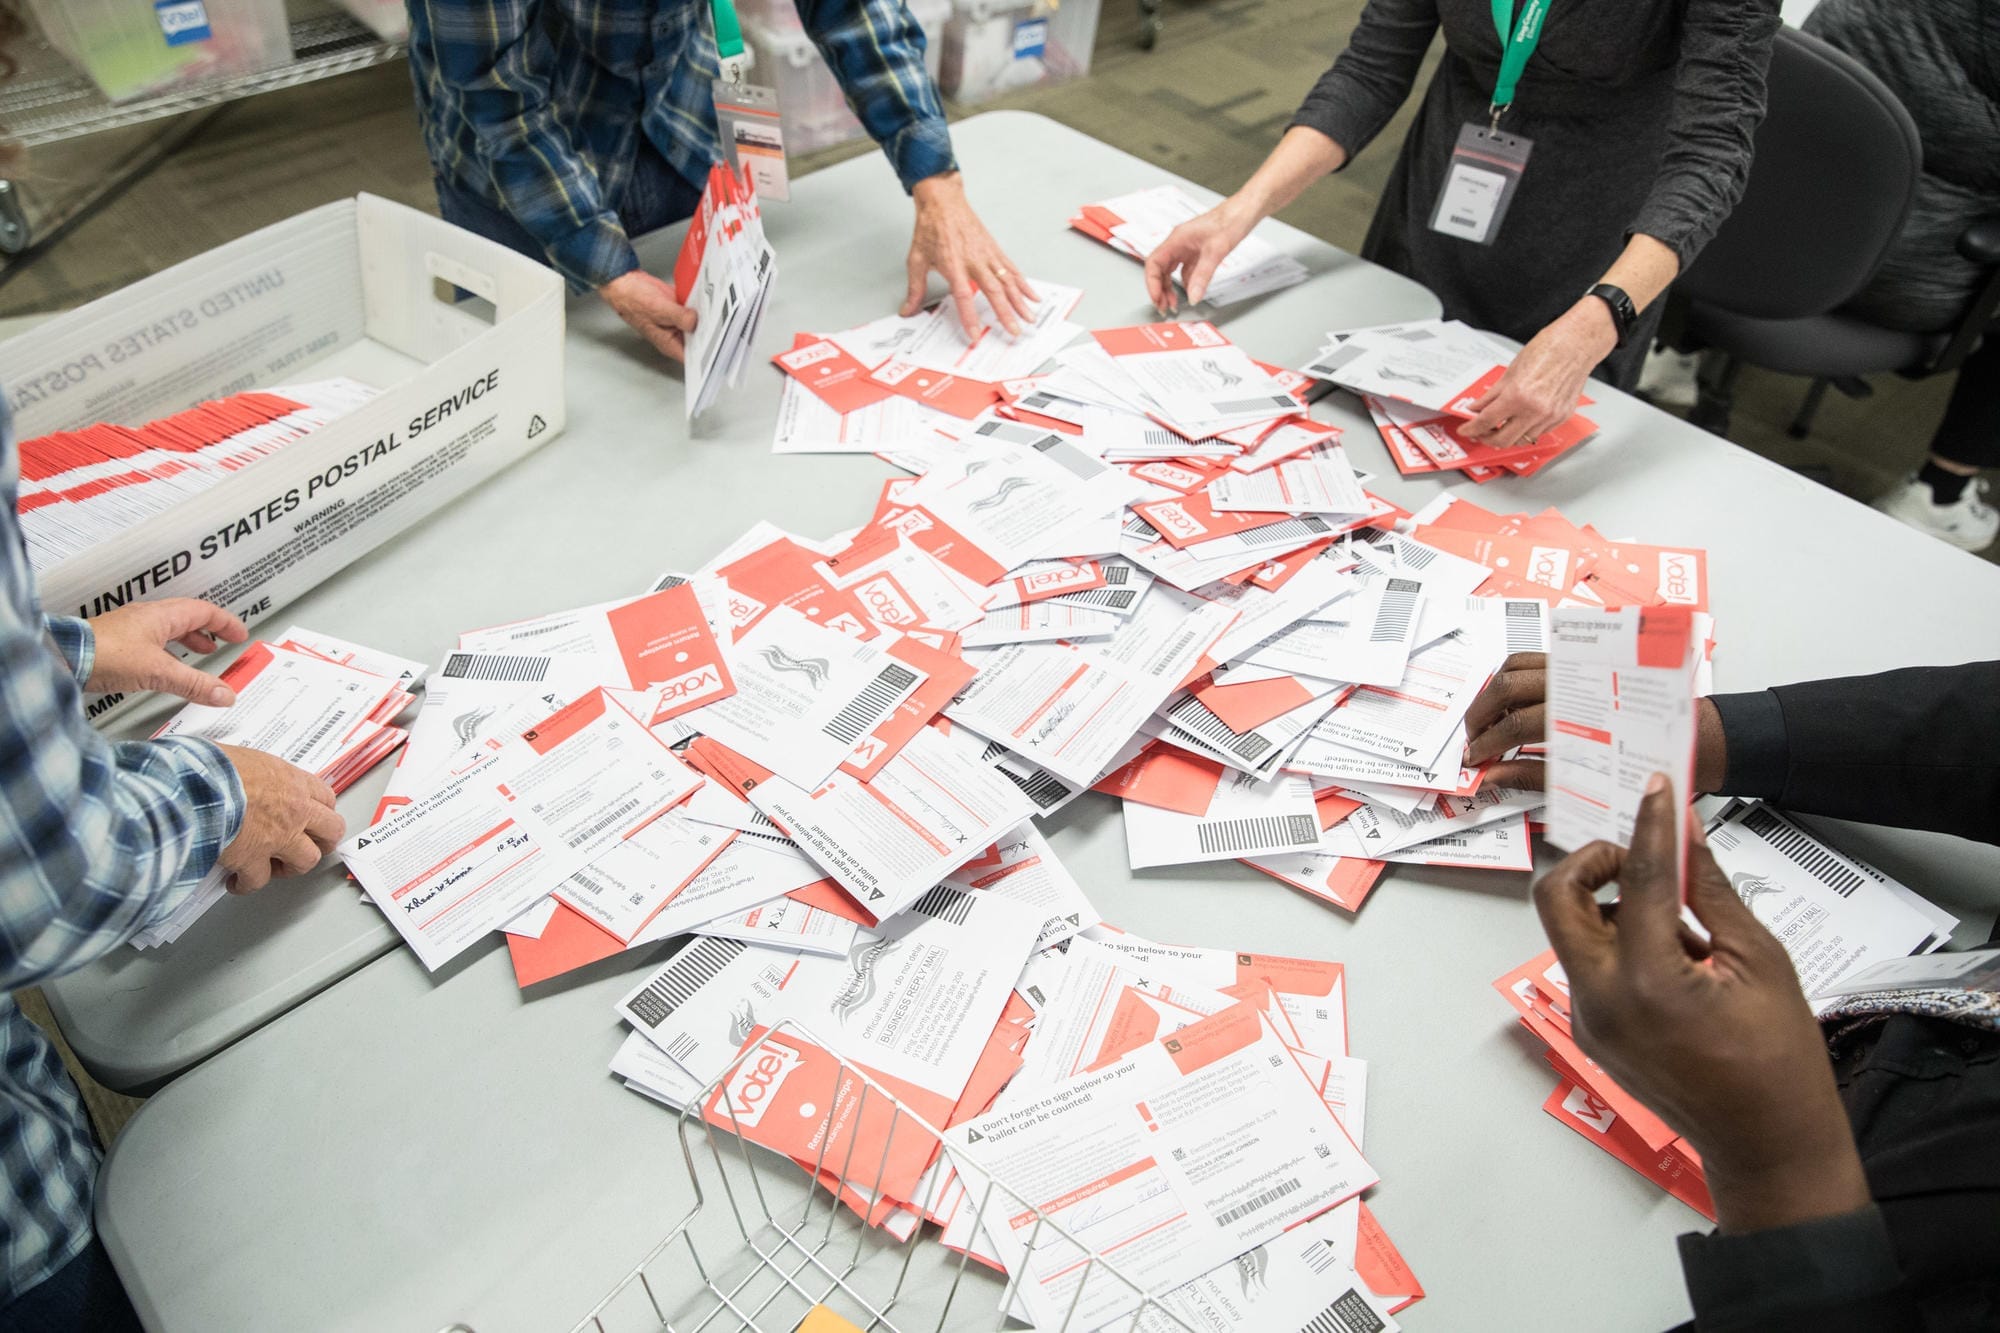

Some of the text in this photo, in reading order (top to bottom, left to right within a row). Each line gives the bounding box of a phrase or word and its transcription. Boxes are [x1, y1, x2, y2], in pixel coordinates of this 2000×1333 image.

[79, 370, 497, 619] UNITED STATES POSTAL SERVICE
[293, 499, 344, 533] WARNING
[1150, 501, 1197, 536] vote!
[209, 579, 228, 593] SOLD
[240, 550, 276, 574] RECYCLED
[242, 554, 280, 580] TRANSPORT
[1028, 561, 1089, 589] vote!
[1666, 556, 1691, 602] vote!
[218, 573, 262, 602] TECHNOLOGY
[864, 583, 910, 630] vote!
[638, 631, 700, 657] Return envelope
[87, 692, 124, 720] MM
[1306, 761, 1333, 770] below
[1324, 755, 1362, 764] counted!
[1335, 763, 1353, 771] sign
[1367, 764, 1393, 777] forget
[1396, 763, 1421, 772] ballot
[1396, 772, 1420, 780] Don't
[369, 822, 392, 837] Don't
[393, 806, 418, 823] forget
[429, 789, 449, 805] sign
[446, 774, 470, 790] below
[481, 756, 499, 769] your
[374, 787, 462, 843] ballot can be counted!
[772, 804, 869, 892] Don't forget to sign below so your
[810, 824, 878, 885] ballot can be counted!
[1042, 923, 1067, 937] Don't
[1782, 906, 1821, 938] REPLY MAIL
[1116, 943, 1135, 952] sign
[1137, 945, 1165, 954] below
[1180, 951, 1202, 959] your
[862, 942, 925, 1039] Official ballot do not delay
[879, 949, 940, 1043] BUSINESS REPLY MAIL
[926, 1011, 943, 1032] Grady
[937, 995, 952, 1011] Way
[945, 984, 957, 996] Ste
[952, 970, 964, 984] 200
[902, 983, 945, 1054] King County Elections
[921, 983, 968, 1062] Renton WA 98057-9815
[724, 1036, 788, 1126] vote!
[982, 1062, 1135, 1131] Don't forget to sign below so your
[807, 1078, 853, 1149] Return velope
[827, 1095, 857, 1143] stamp needed
[987, 1092, 1092, 1142] ballot can be counted!
[1184, 1137, 1259, 1175] NICHOLAS JEROME JOHNSON
[1185, 1283, 1228, 1333] PLY MAIL
[1205, 1279, 1243, 1322] not delay
[1334, 1303, 1352, 1322] UNITED
[1338, 1300, 1357, 1319] MAILED
[1342, 1297, 1373, 1324] NECESSARY
[1350, 1294, 1381, 1325] NO POSTAGE
